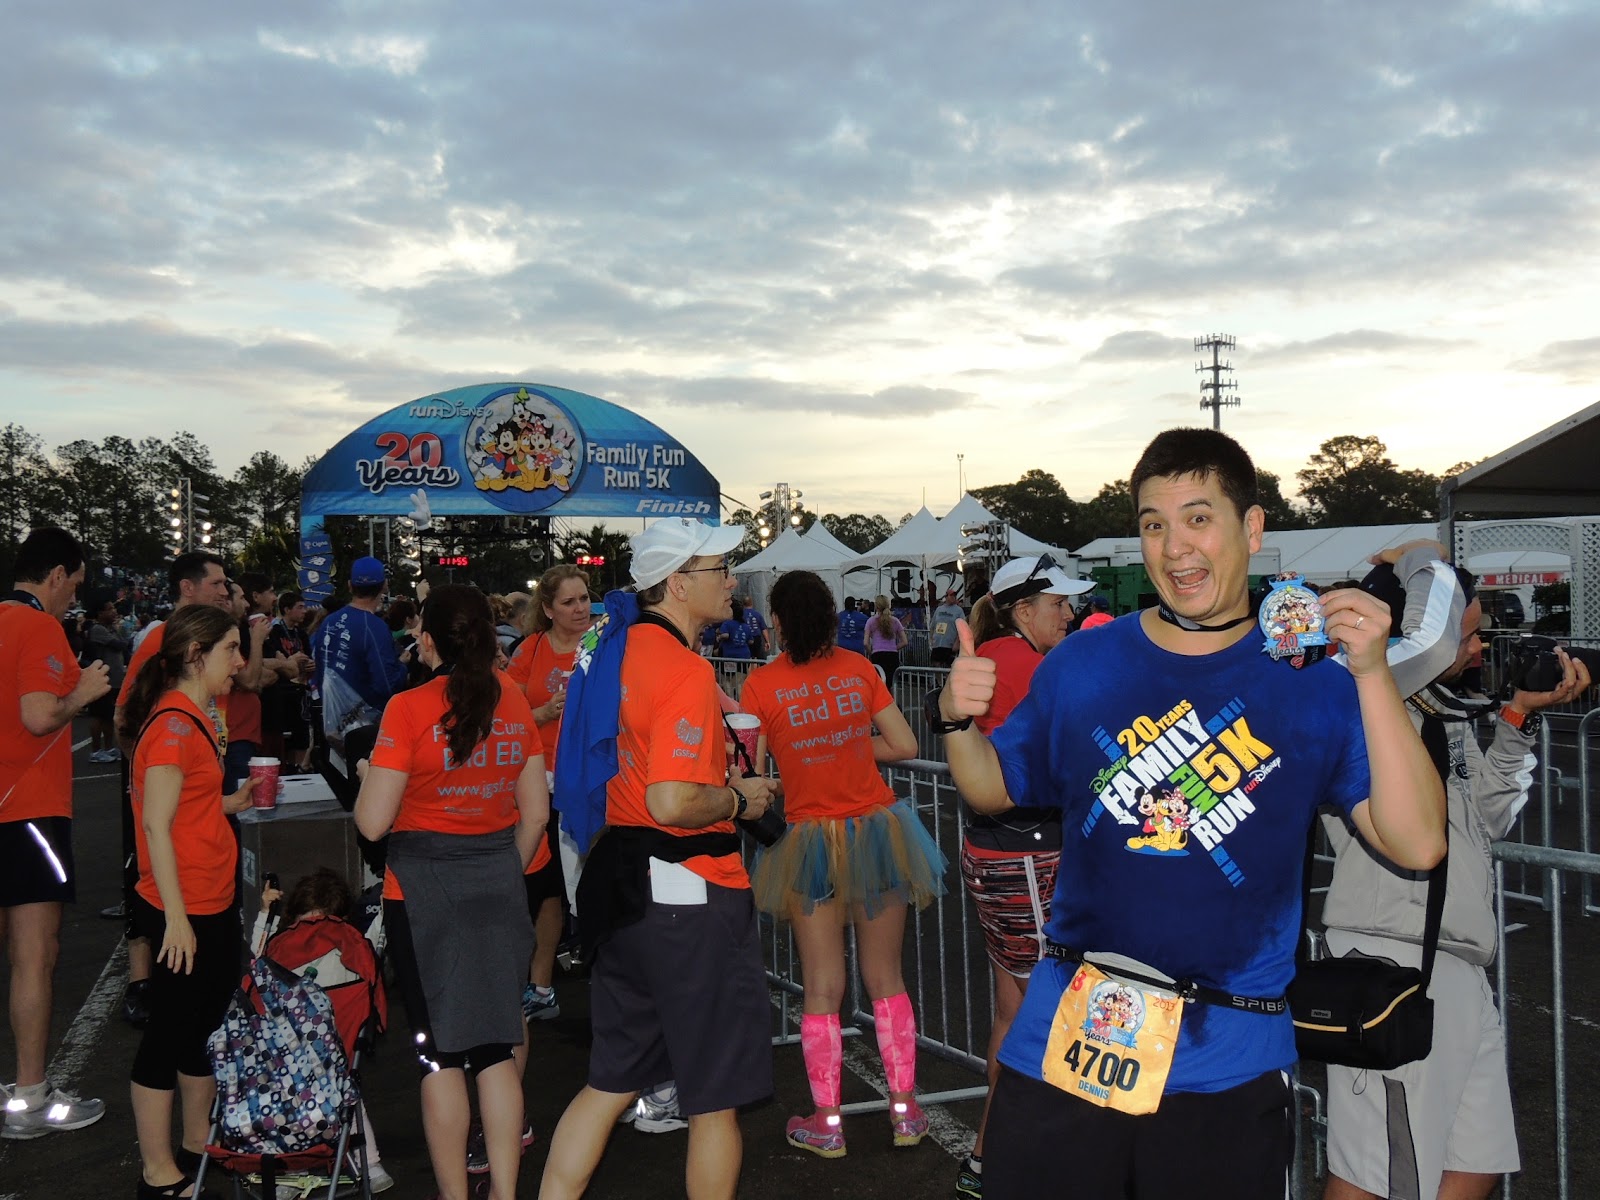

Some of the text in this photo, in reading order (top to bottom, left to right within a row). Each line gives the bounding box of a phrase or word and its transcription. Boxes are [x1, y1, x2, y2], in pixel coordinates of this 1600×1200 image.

[375, 431, 442, 468] 20
[586, 442, 685, 469] Family Fun
[356, 458, 460, 493] Years
[604, 467, 671, 489] Run 5K
[635, 499, 711, 514] Finish
[1495, 573, 1544, 585] MEDICAL
[1269, 647, 1305, 661] Years
[1274, 633, 1298, 650] 20
[775, 683, 809, 704] Find
[813, 684, 822, 695] a
[787, 699, 829, 727] End
[1117, 699, 1193, 758] 20 YEARS
[1099, 709, 1210, 821] FAMILY
[1189, 716, 1274, 794] 5K
[1168, 763, 1220, 815] FUN
[1190, 787, 1256, 851] RUN
[1152, 998, 1176, 1012] 2013
[1084, 1027, 1112, 1046] Years
[1064, 1039, 1140, 1092] 4700
[1078, 1079, 1109, 1100] DENNIS
